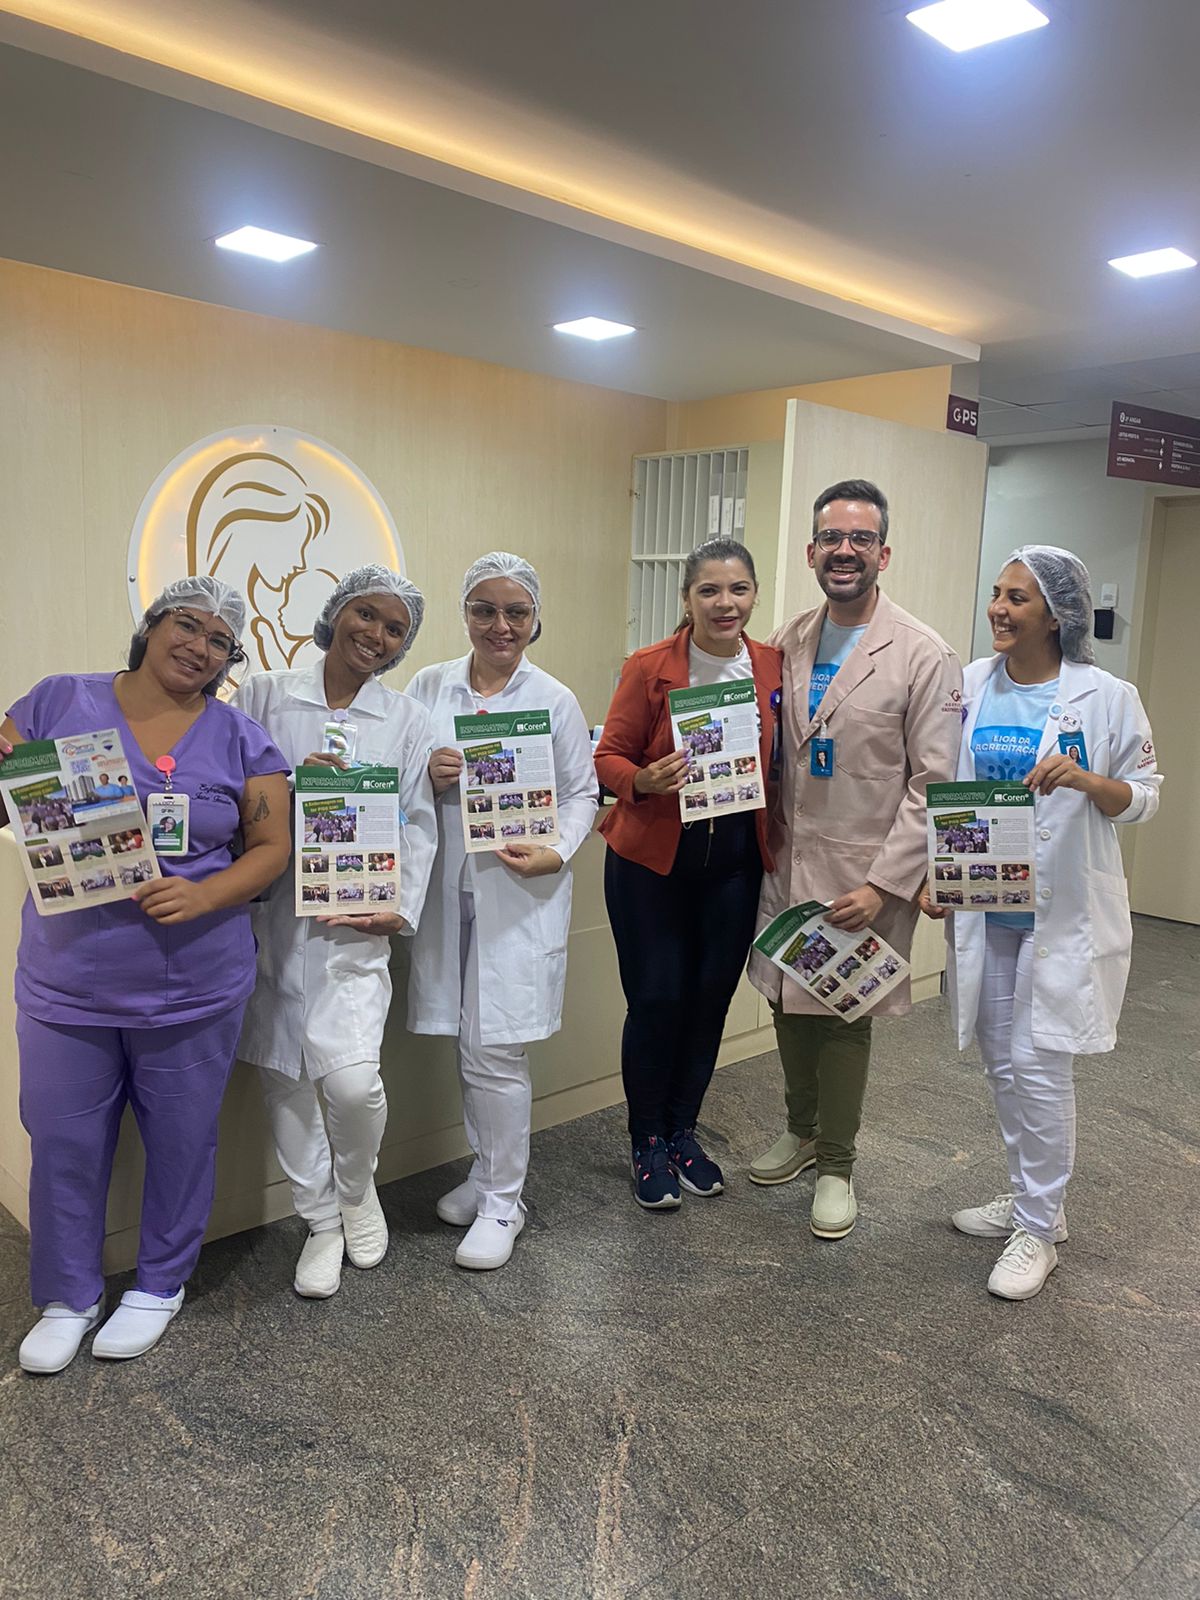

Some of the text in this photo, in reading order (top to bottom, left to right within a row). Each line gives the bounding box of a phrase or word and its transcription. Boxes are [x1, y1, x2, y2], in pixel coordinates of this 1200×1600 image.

[993, 735, 1031, 745] LIGA DA
[301, 777, 355, 787] INFORMATIVO
[931, 792, 1026, 802] INFORMATIVO Coren
